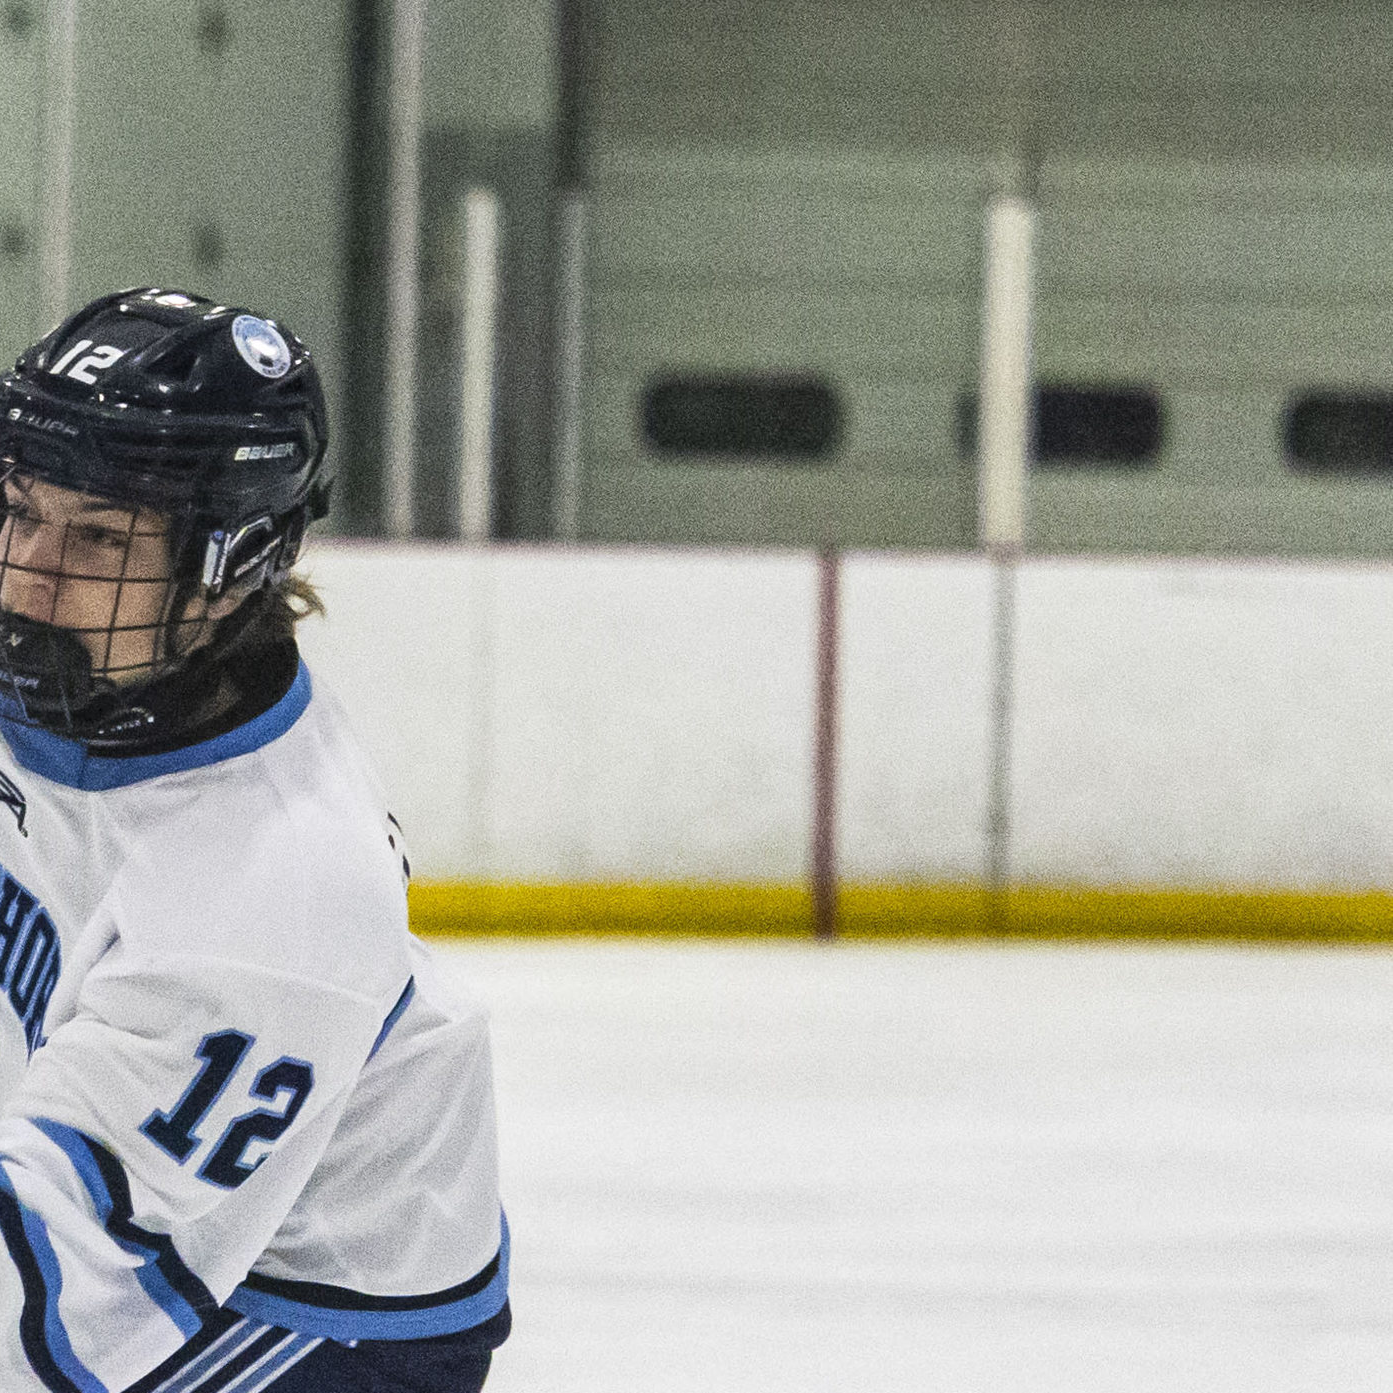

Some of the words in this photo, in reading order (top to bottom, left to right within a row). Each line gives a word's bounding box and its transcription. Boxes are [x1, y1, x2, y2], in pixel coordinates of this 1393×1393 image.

[51, 339, 124, 385] 12
[234, 442, 295, 461] BAUER
[137, 1027, 315, 1192] 12
